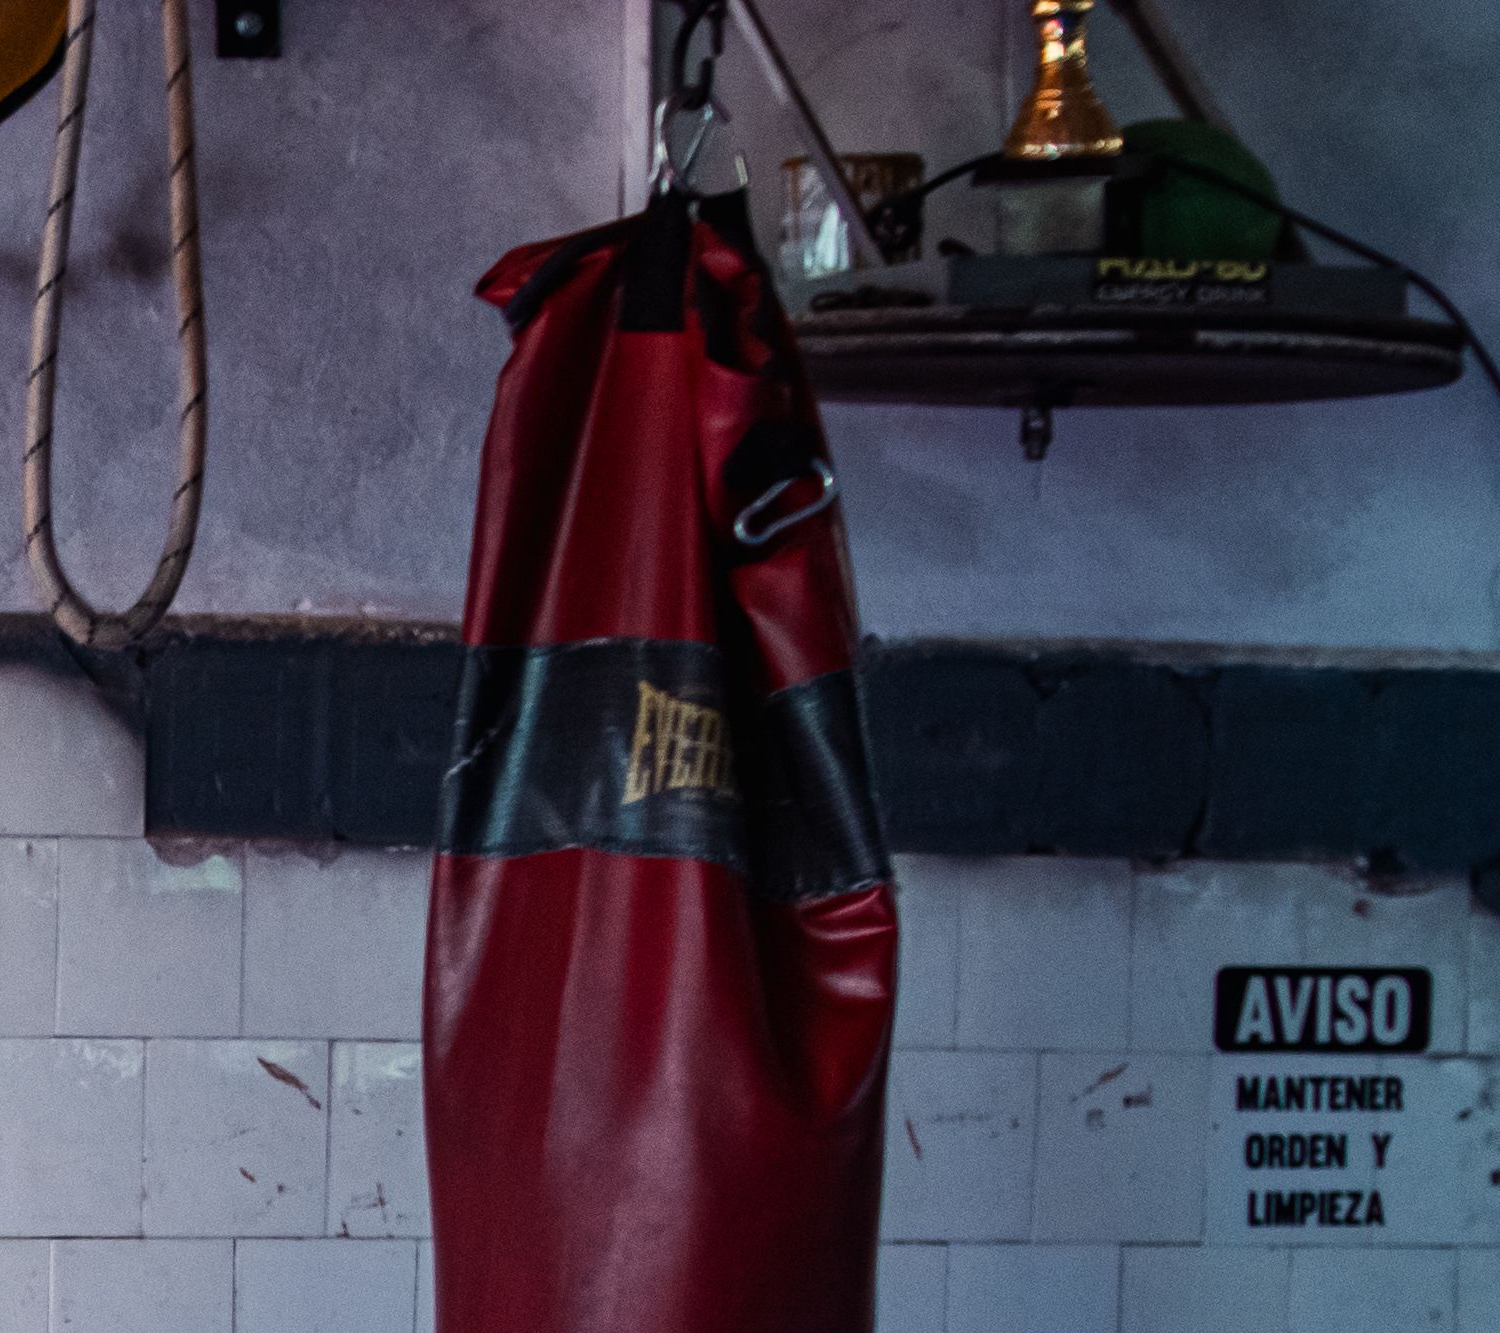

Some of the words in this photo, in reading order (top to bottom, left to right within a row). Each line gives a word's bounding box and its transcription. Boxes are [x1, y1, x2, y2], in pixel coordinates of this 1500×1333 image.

[1233, 974, 1412, 1045] AVISO
[1235, 1074, 1405, 1113] MANTENER
[1244, 1133, 1347, 1170] ORDEN
[1370, 1133, 1392, 1169] Y
[1246, 1189, 1385, 1228] LIMPIEZA
